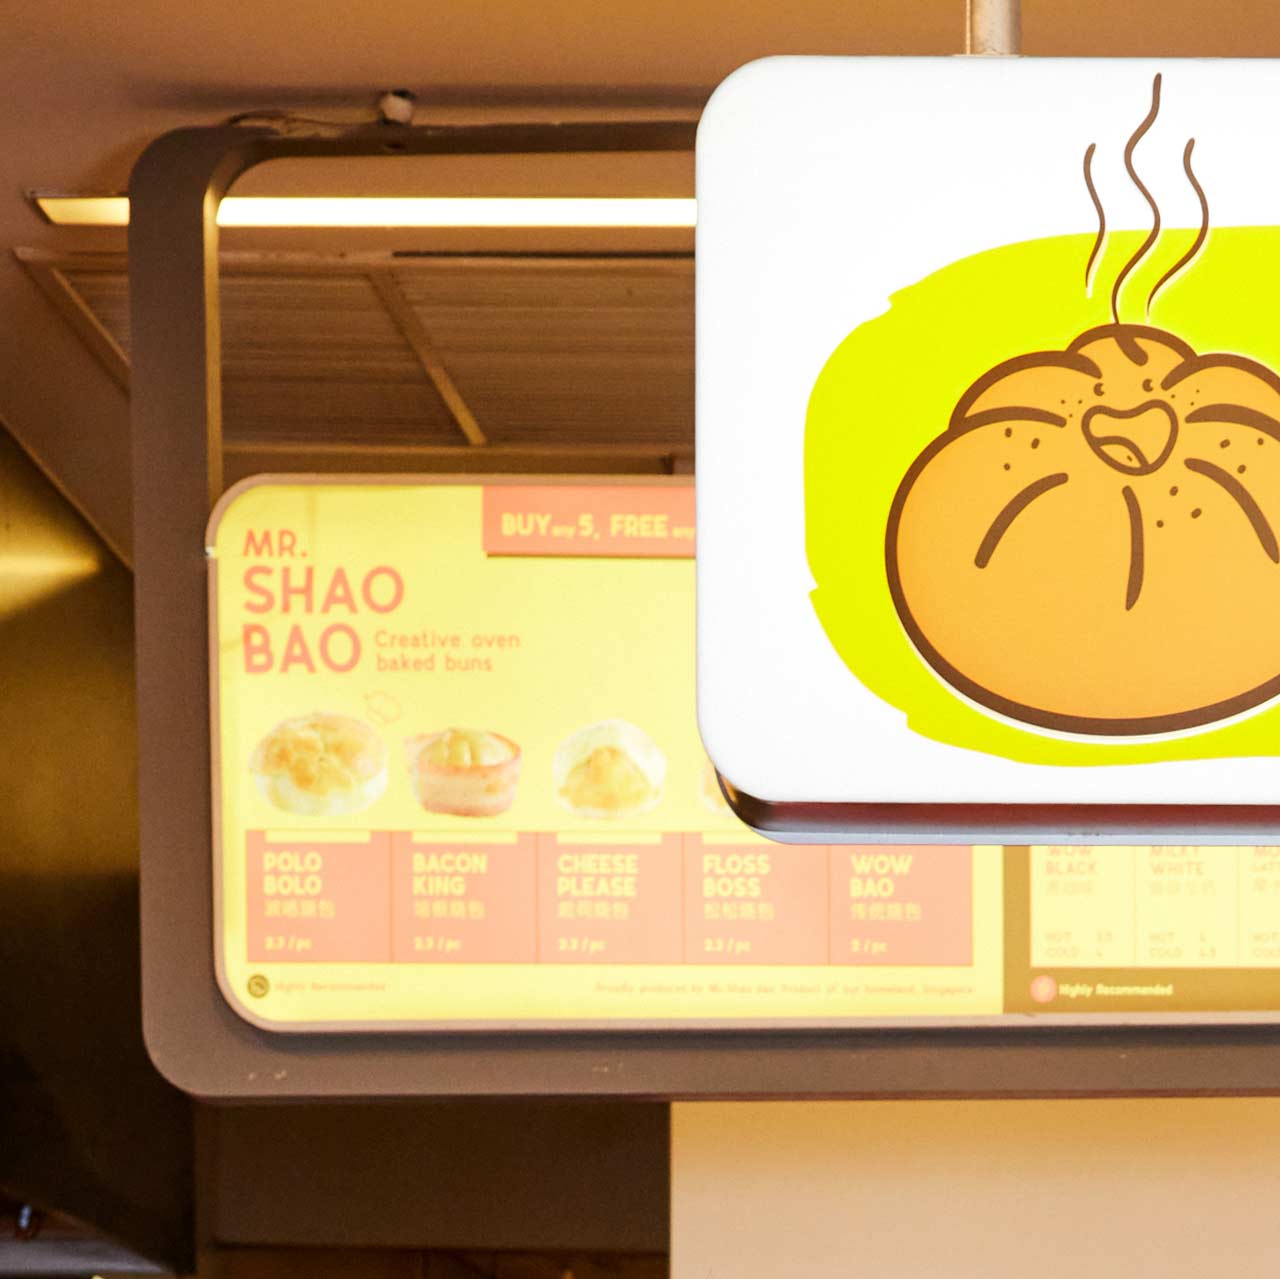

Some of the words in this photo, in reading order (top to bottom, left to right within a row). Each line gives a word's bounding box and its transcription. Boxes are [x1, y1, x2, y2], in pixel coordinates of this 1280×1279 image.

[501, 513, 552, 537] BUY
[609, 513, 670, 538] FREE
[242, 529, 309, 558] MR.
[242, 564, 405, 615] SHAO
[242, 623, 362, 674] BAO
[374, 630, 461, 650] Creative
[470, 634, 520, 650] oven
[376, 654, 436, 672] baked
[445, 654, 494, 672] buns
[262, 851, 323, 873] POLO
[412, 852, 489, 874] BACON
[557, 853, 640, 875] CHEESE
[702, 853, 771, 875] FLOSS
[850, 853, 914, 875] WOW
[1045, 861, 1097, 875] BLACK
[1150, 861, 1206, 876] WHITE
[262, 874, 323, 896] BOLO
[412, 875, 467, 896] KING
[556, 876, 637, 897] PLEASE
[702, 877, 761, 898] BOSS
[849, 877, 895, 898] BAO
